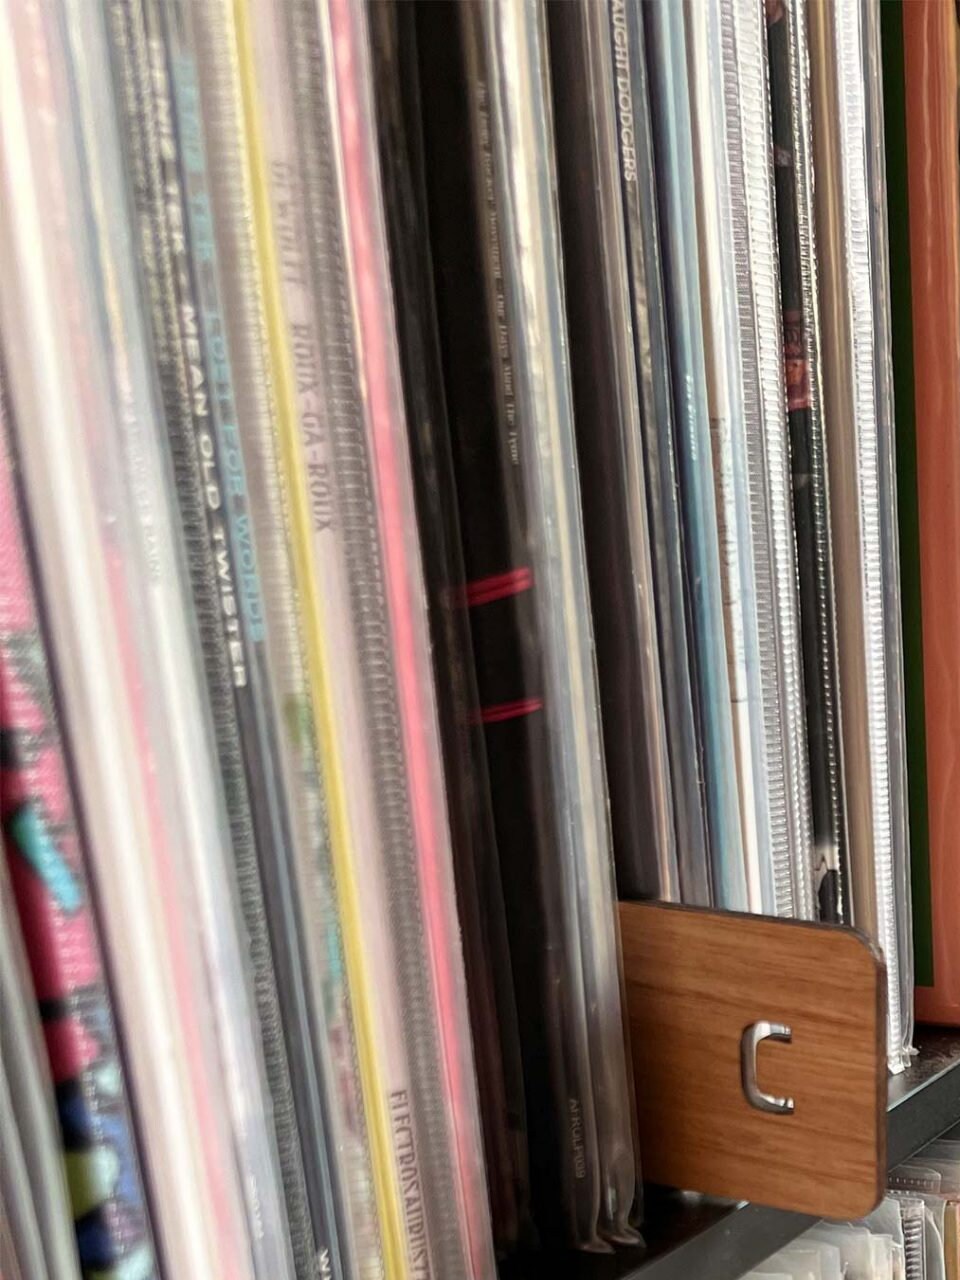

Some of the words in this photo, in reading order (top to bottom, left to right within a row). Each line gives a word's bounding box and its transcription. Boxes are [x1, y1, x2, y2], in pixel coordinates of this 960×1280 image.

[181, 304, 209, 417] MEAN
[198, 432, 221, 510] OLD
[212, 526, 247, 688] TWISTER
[740, 1020, 794, 1115] C
